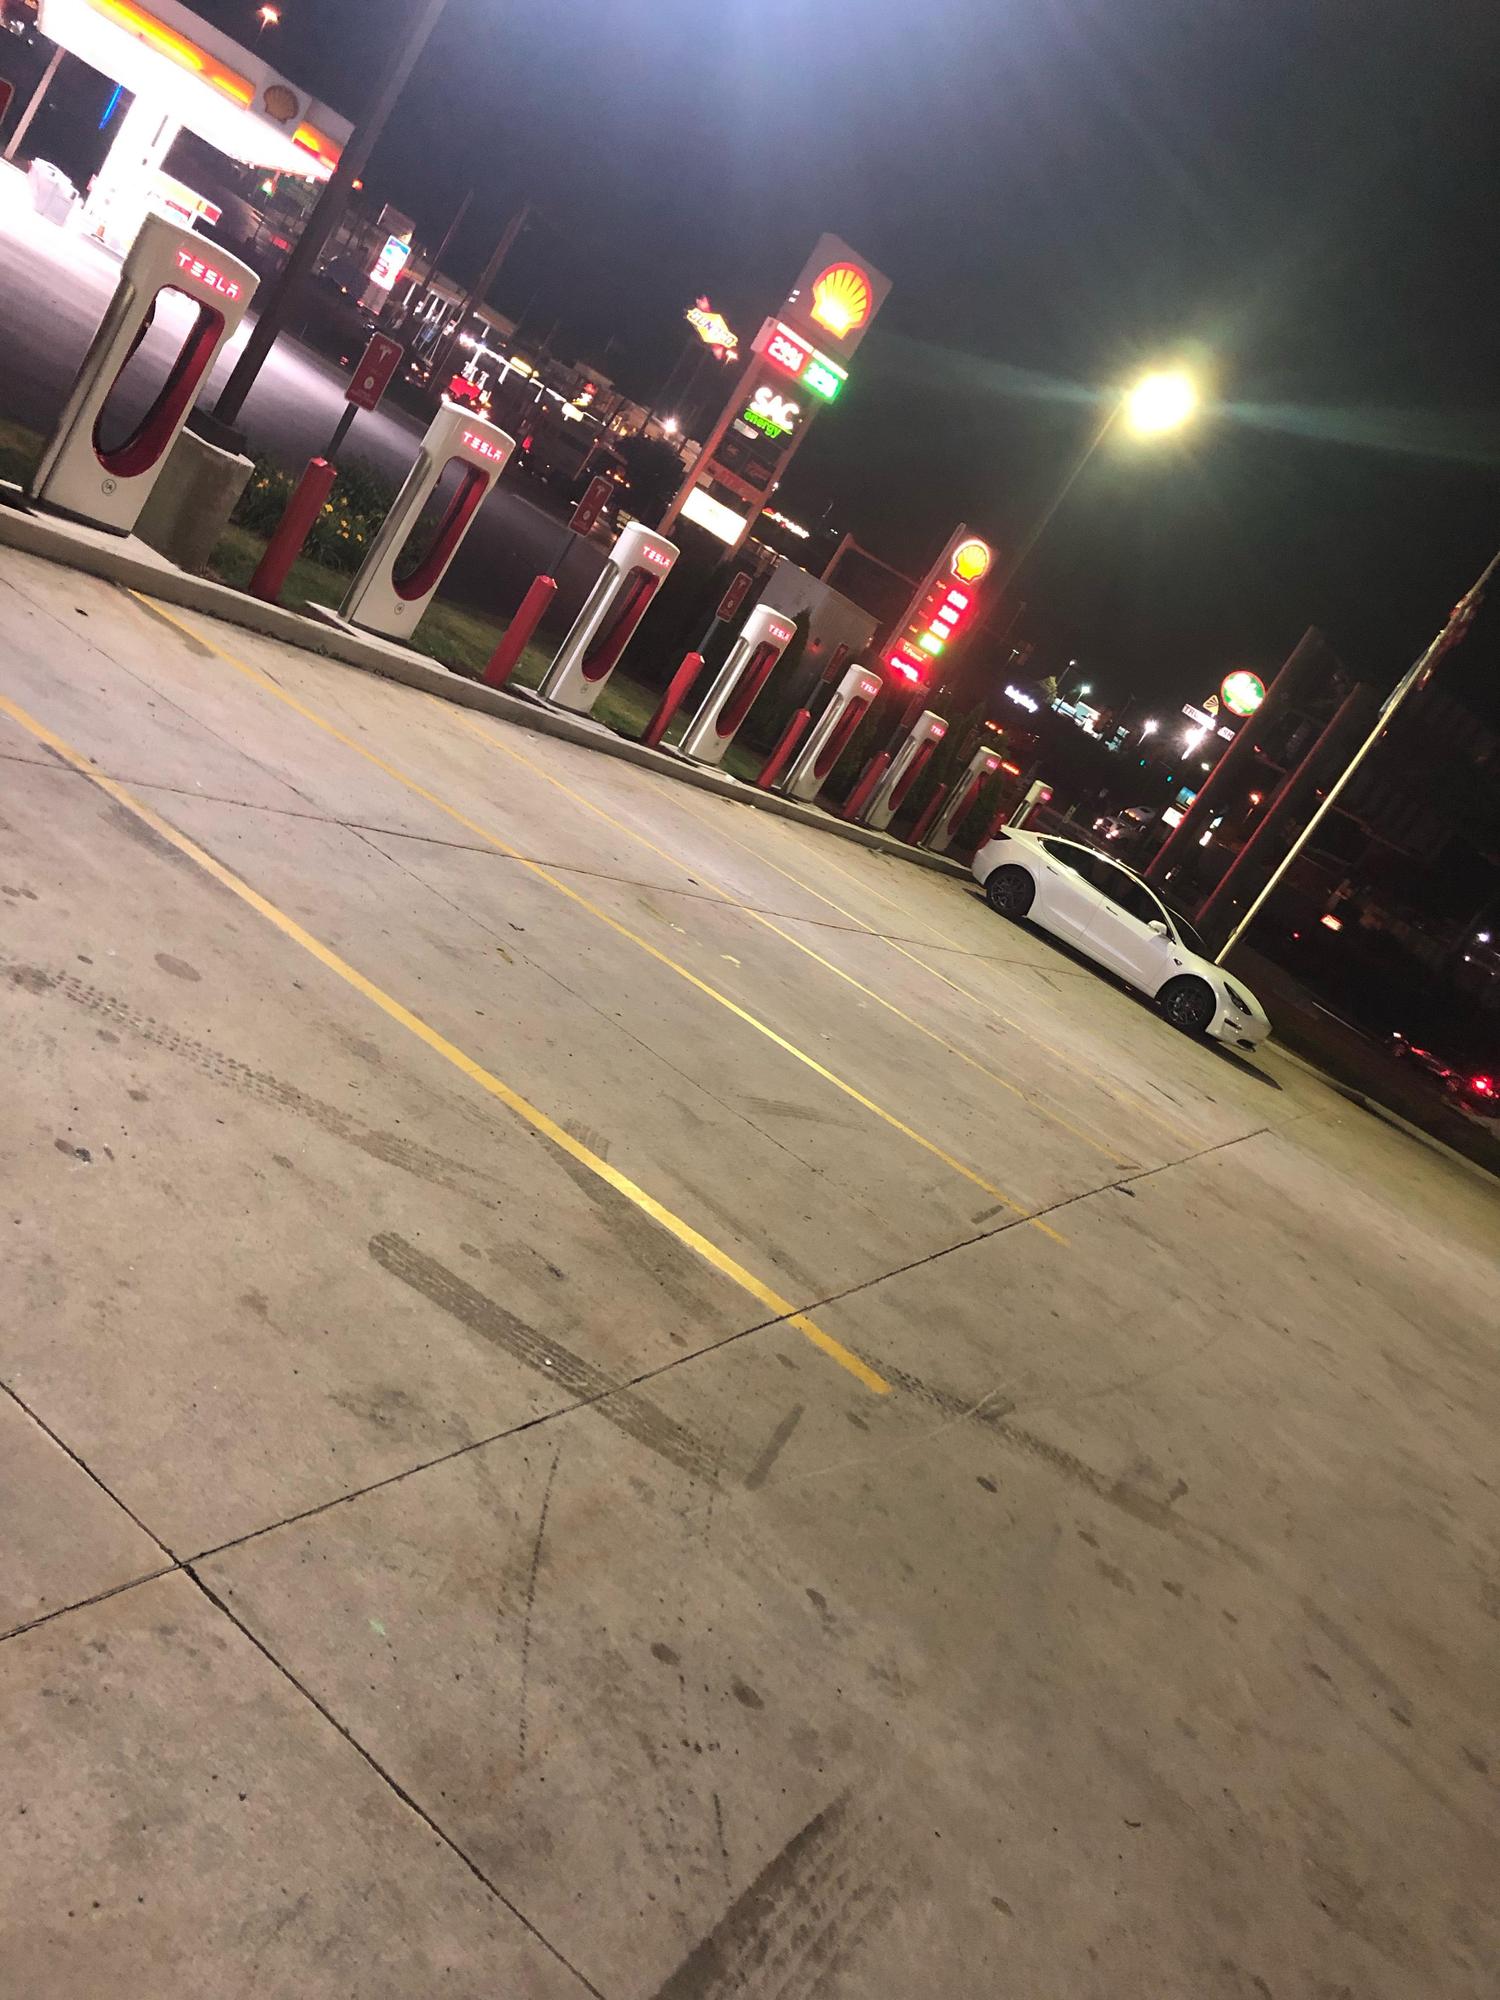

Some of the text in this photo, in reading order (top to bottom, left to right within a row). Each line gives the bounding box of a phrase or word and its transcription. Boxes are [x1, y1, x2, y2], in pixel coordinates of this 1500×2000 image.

[177, 250, 240, 298] TESLA
[748, 386, 800, 430] SAC
[743, 411, 782, 438] energy
[463, 431, 503, 460] TESLA
[643, 545, 671, 568] TESLA
[768, 624, 790, 642] TESLA
